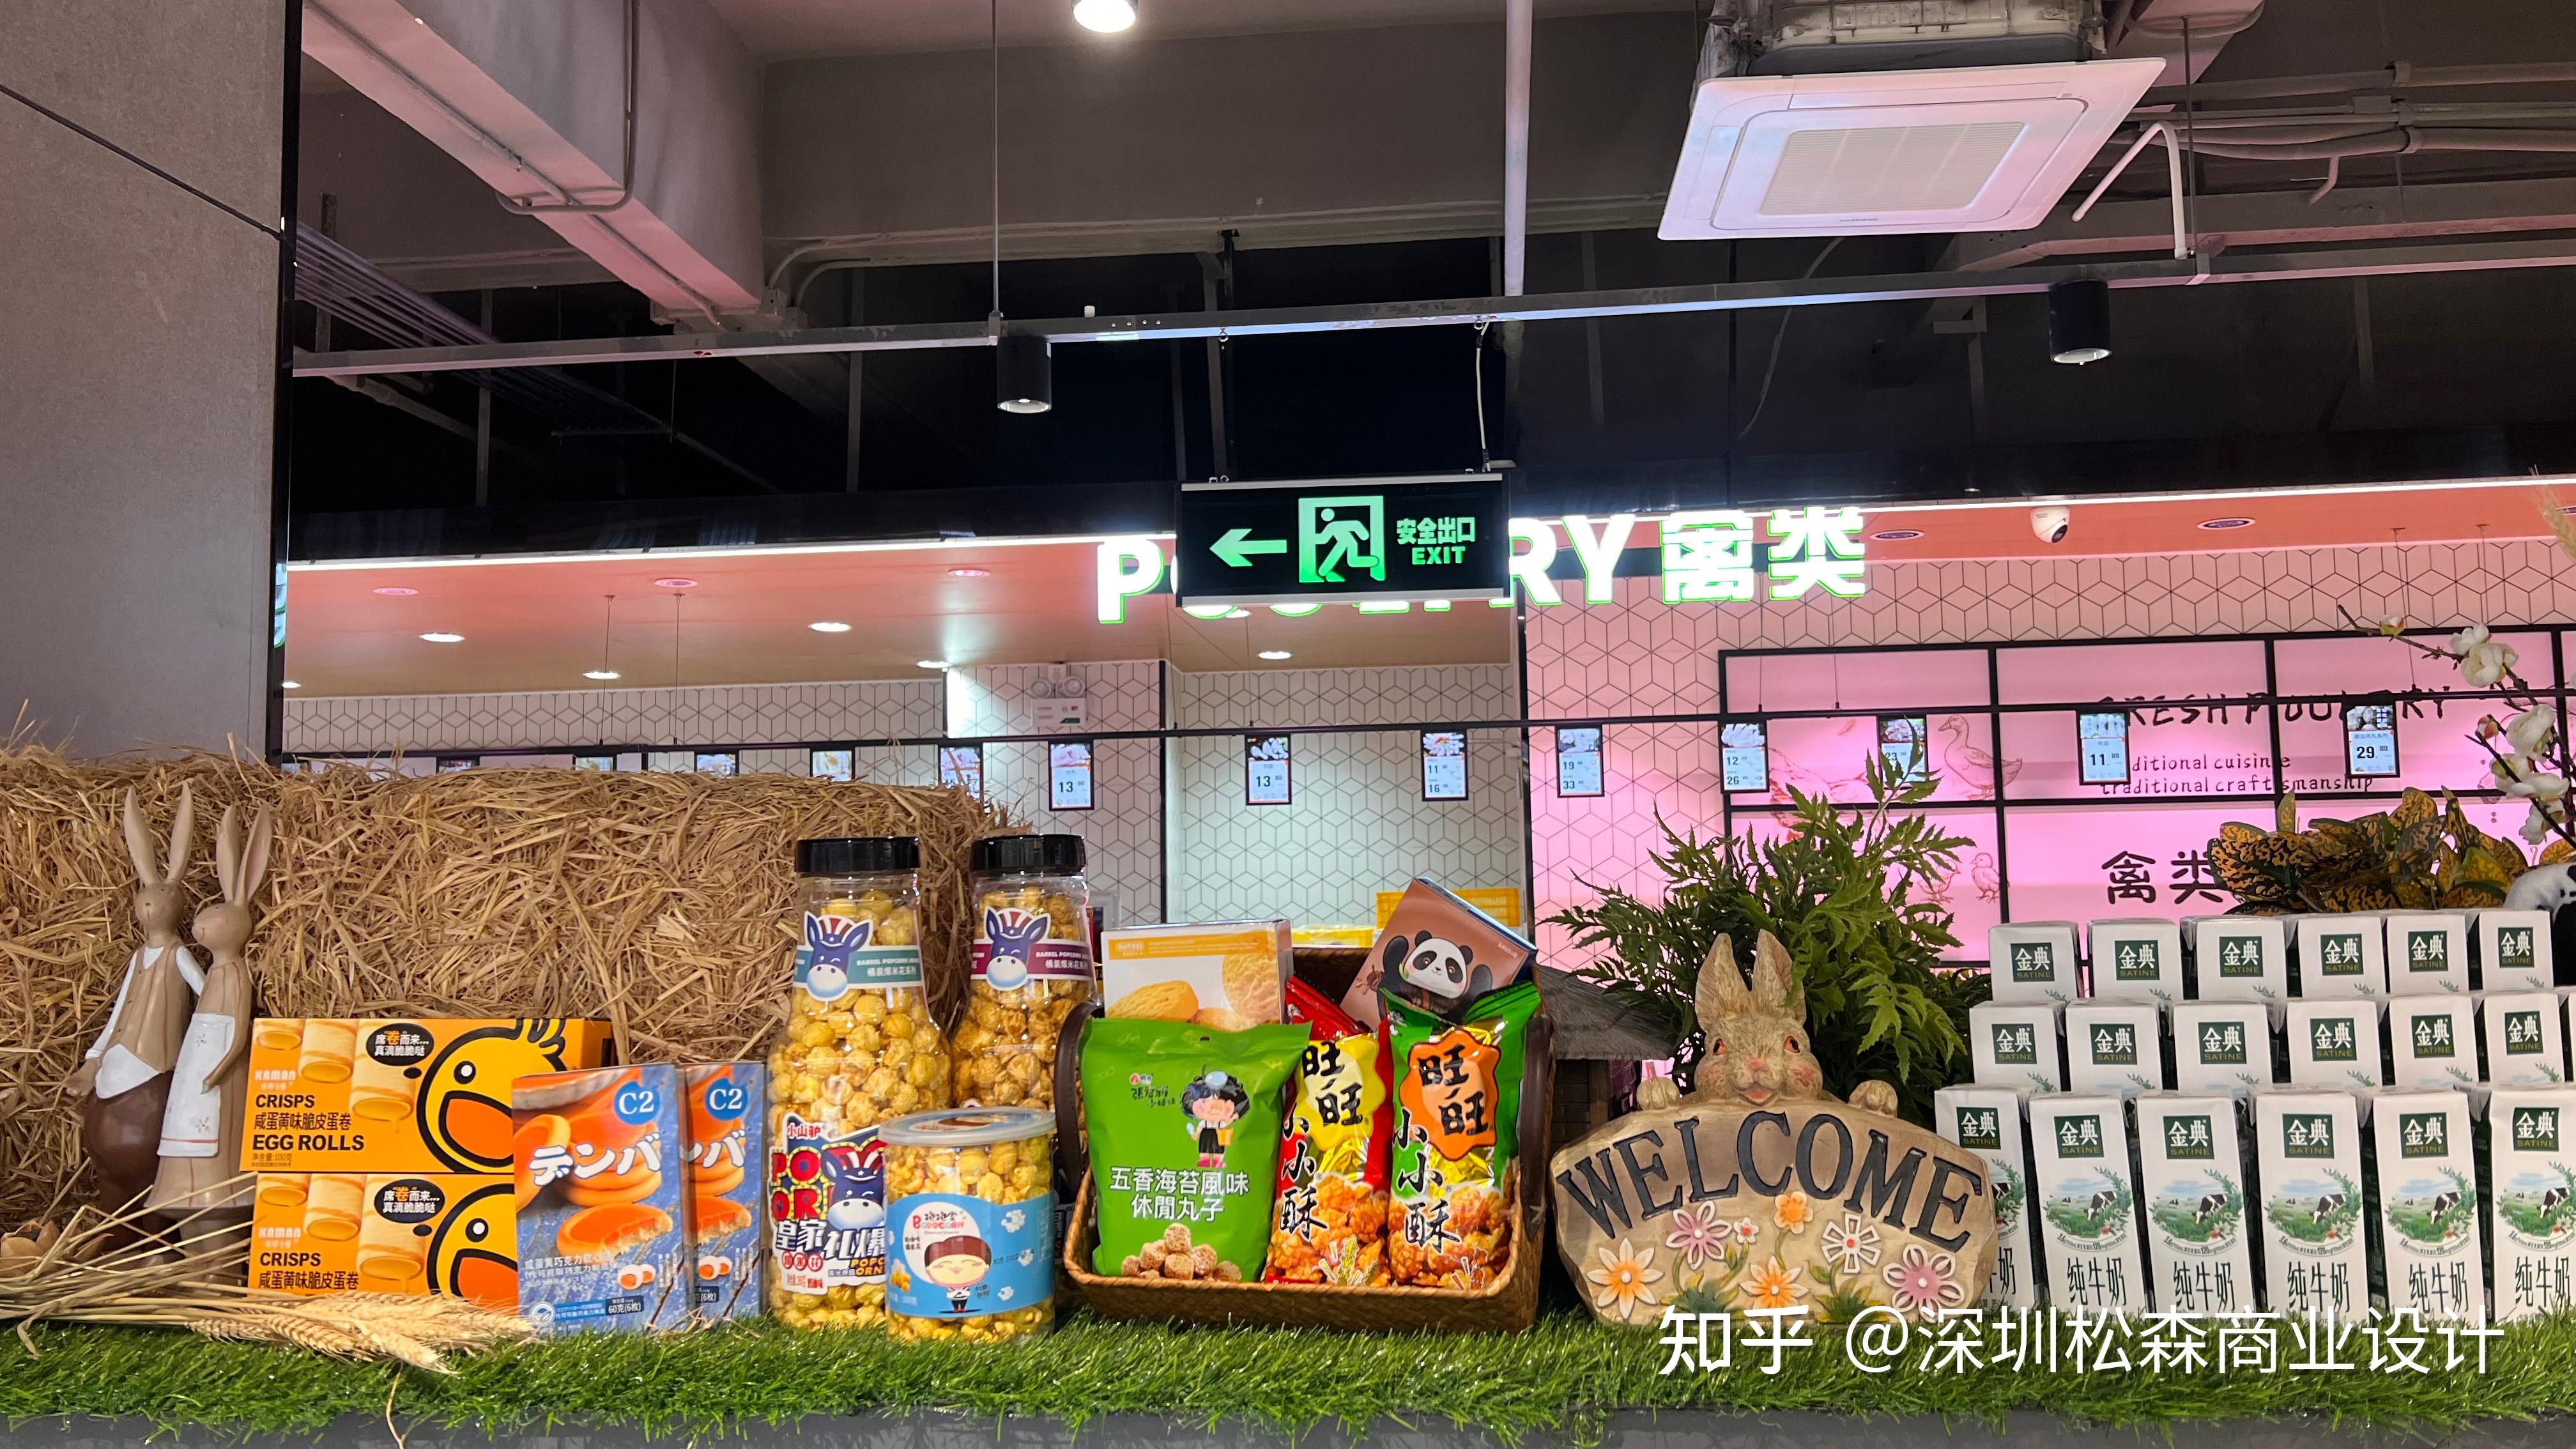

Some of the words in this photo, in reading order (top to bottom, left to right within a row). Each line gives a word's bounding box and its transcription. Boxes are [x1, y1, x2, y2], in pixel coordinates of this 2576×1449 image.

[1397, 517, 1476, 545] 安全出口
[1411, 546, 1466, 565] EXIT
[1660, 507, 1866, 604] 禽类
[2098, 693, 2228, 726] RESH
[1429, 765, 1438, 774] 11
[1563, 762, 1574, 770] 19
[1727, 756, 1738, 765] 12
[2214, 753, 2290, 769] cuisine
[1429, 784, 1439, 792] 16
[1563, 781, 1575, 789] 33
[1727, 776, 1739, 785] 26
[2101, 777, 2208, 795] traditional
[2215, 774, 2373, 793] craftsmanship
[2101, 850, 2230, 906] 禽类
[2223, 940, 2259, 965] 金典
[2324, 938, 2359, 963] 金典
[2411, 935, 2444, 960] 金典
[2501, 931, 2531, 956] 金典
[2016, 947, 2050, 970] 金典
[2119, 944, 2155, 969] 金典
[1997, 1027, 2032, 1052] 金典
[2095, 1028, 2132, 1053] 金典
[2203, 1026, 2241, 1052] 金典
[2315, 1022, 2351, 1048] 金典
[2416, 1018, 2450, 1046] 金典
[2508, 1015, 2538, 1043] 金典
[256, 1094, 315, 1108] CRISPS
[618, 1091, 655, 1115] C2
[709, 1087, 742, 1110] C2
[254, 1112, 351, 1130] 咸蛋黄味脆皮蛋卷
[788, 1124, 820, 1138] 小山驴
[1961, 1112, 1996, 1137] 金典
[2060, 1119, 2098, 1146] 金典
[2168, 1120, 2208, 1147] 金典
[2287, 1119, 2329, 1146] 金典
[2404, 1117, 2443, 1146] 金典
[2516, 1112, 2554, 1138] 金典
[252, 1134, 294, 1151] EGG
[298, 1135, 364, 1151] ROLLS
[2062, 1146, 2099, 1154] SATINE
[2170, 1147, 2210, 1156] SATINE
[2289, 1146, 2329, 1154] SATINE
[2406, 1146, 2444, 1154] SATINE
[1110, 1165, 1249, 1197] 五香海苔風味
[1281, 1102, 1328, 1243] 小小酥
[1393, 1108, 1461, 1254] 小小酥
[1556, 1111, 1982, 1252] WELCOME
[260, 1252, 321, 1268] CRISPS
[258, 1271, 359, 1290] 咸蛋黄味脆皮蛋卷
[2067, 1257, 2127, 1305] 纯牛奶
[2174, 1261, 2235, 1311] 纯牛奶
[2287, 1261, 2350, 1312] 纯牛奶
[2409, 1262, 2469, 1313] 纯牛奶
[2515, 1256, 2570, 1310] 纯牛奶
